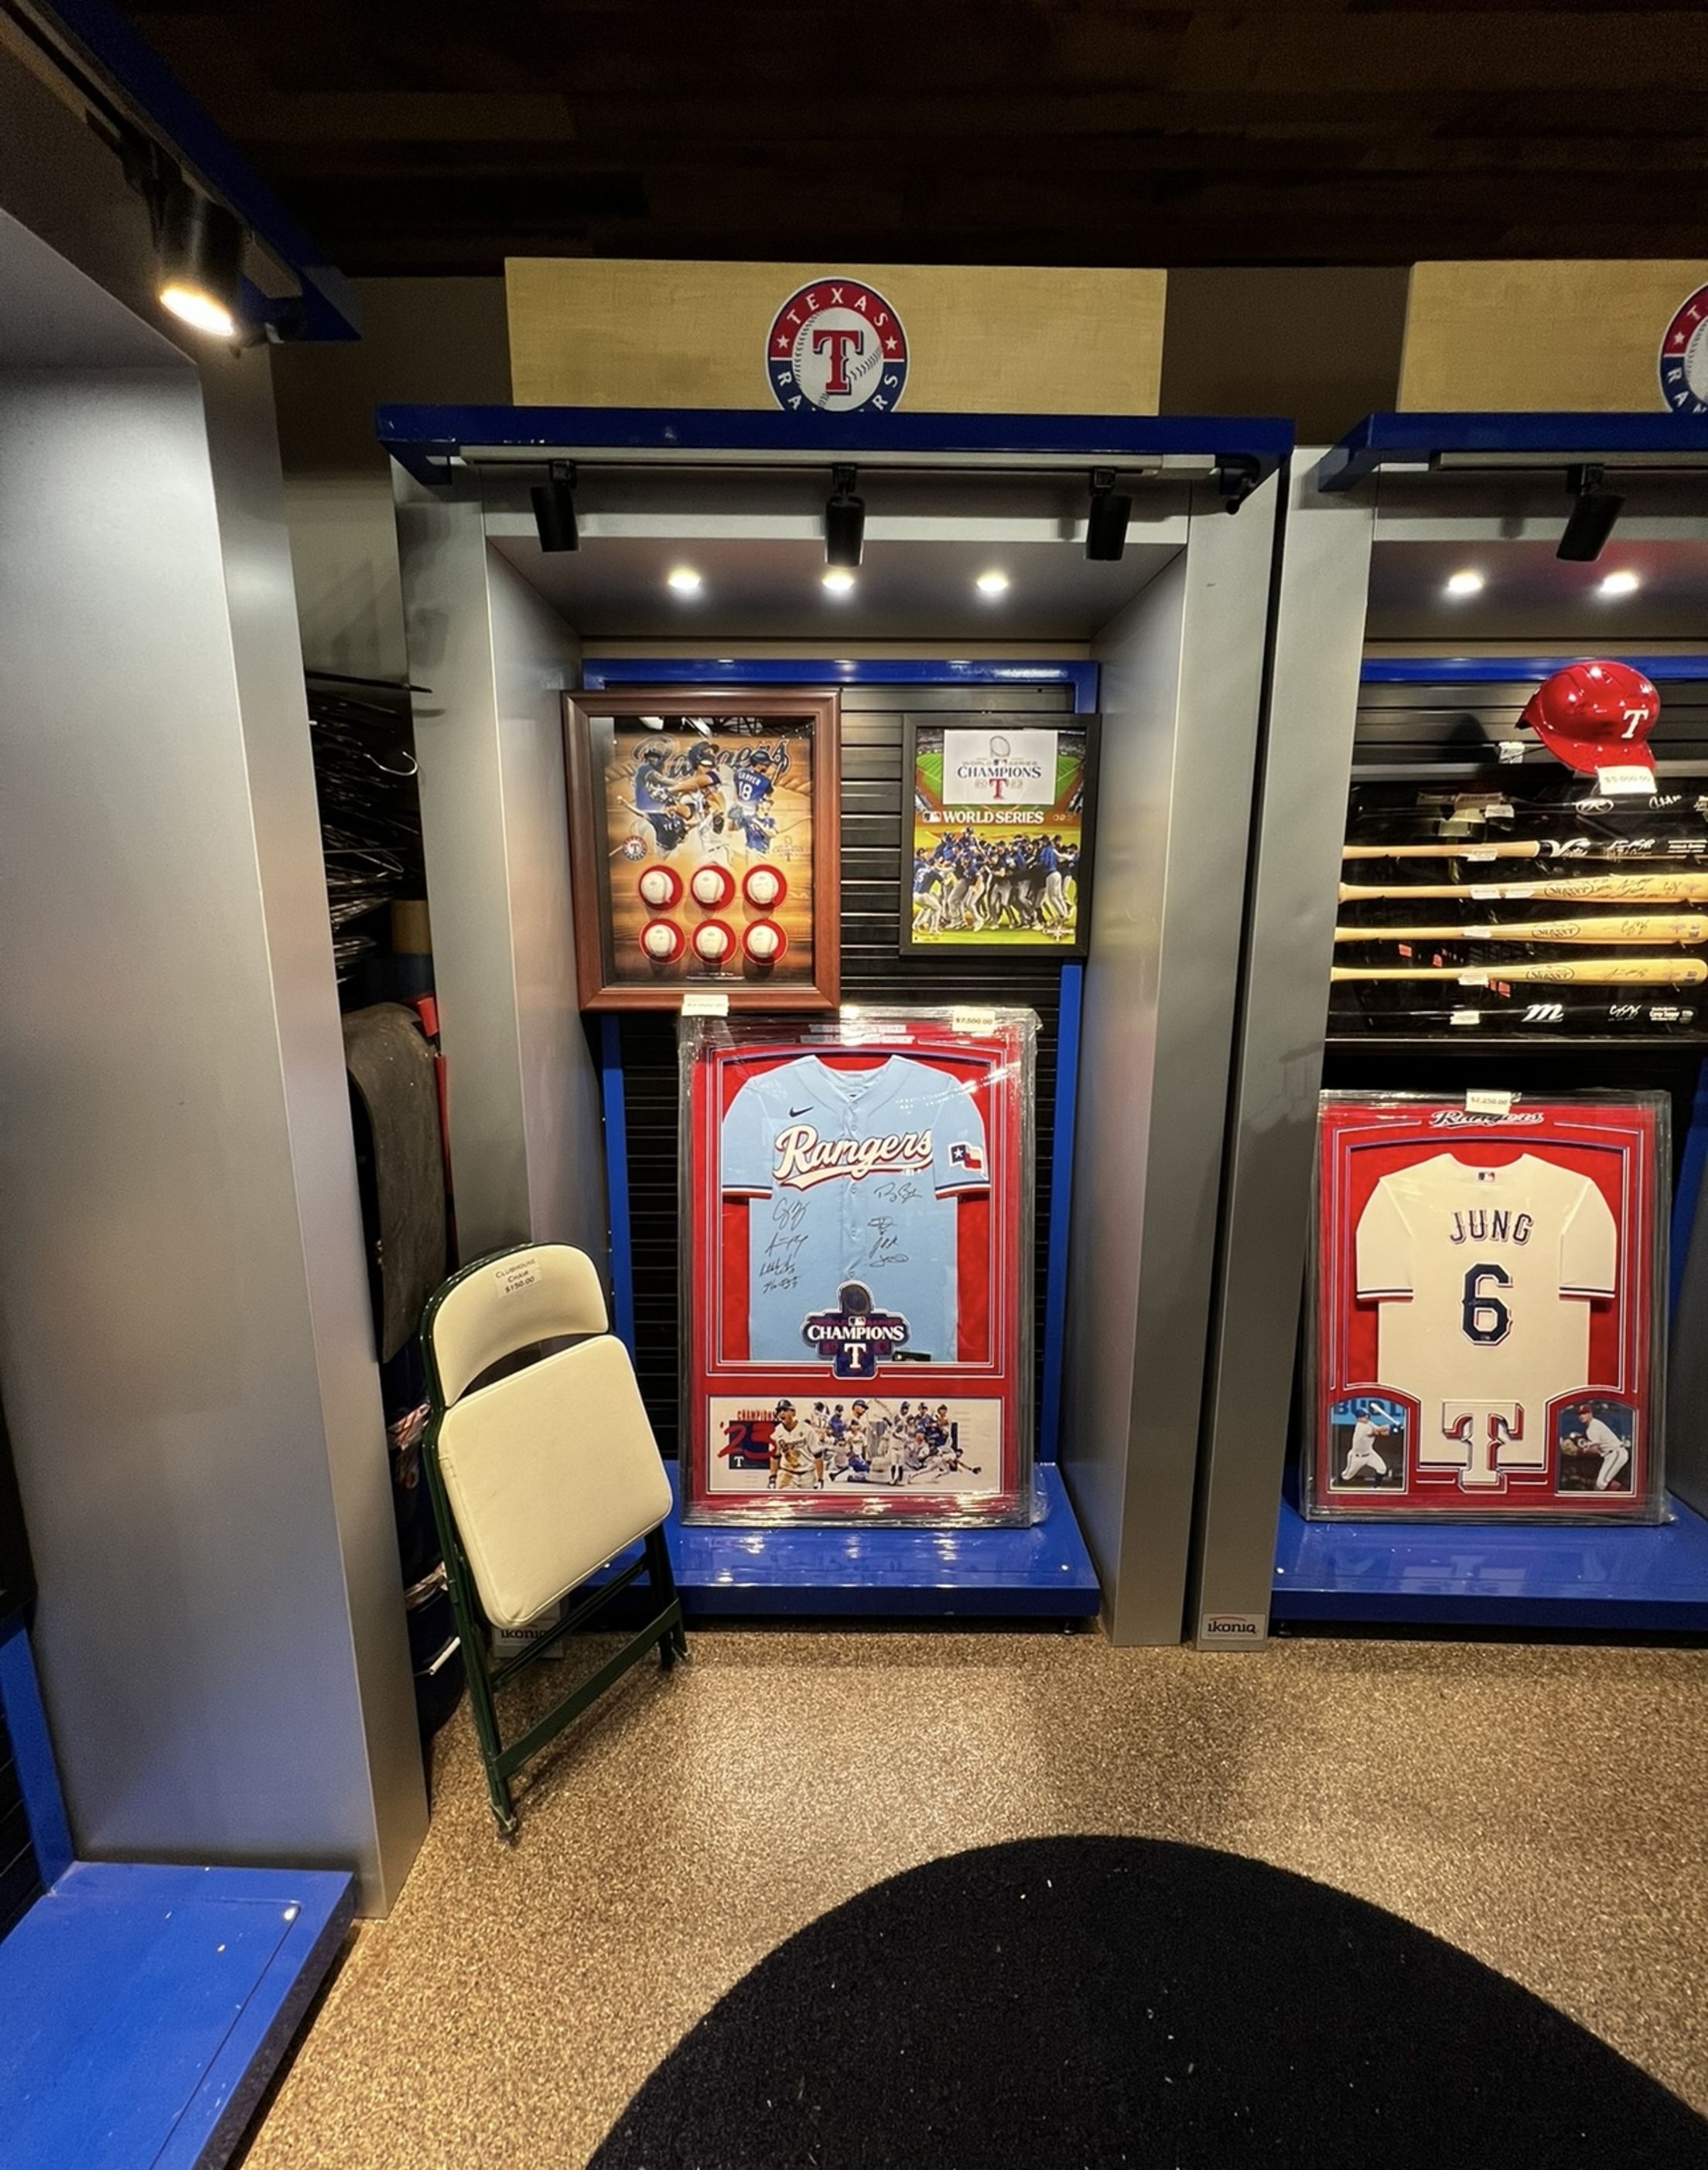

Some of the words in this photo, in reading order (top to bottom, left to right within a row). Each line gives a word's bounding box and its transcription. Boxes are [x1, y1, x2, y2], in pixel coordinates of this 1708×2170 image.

[787, 287, 889, 326] TEXAS
[812, 330, 864, 395] T
[777, 371, 899, 412] RARS
[1621, 709, 1649, 739] T
[957, 766, 1042, 778] CHAMPIONS
[739, 781, 753, 801] 18
[943, 811, 994, 824] WORLD
[996, 811, 1044, 824] SERIES
[955, 1017, 993, 1026] $7,500.00
[772, 1123, 934, 1185] Rangers
[1450, 1208, 1535, 1246] JUNG
[1461, 1263, 1514, 1346] 6
[807, 1324, 905, 1341] CHAMPIONS
[844, 1342, 867, 1369] T
[1440, 1399, 1525, 1494] T
[733, 1455, 744, 1468] T
[1208, 1620, 1257, 1635] ikoniq
